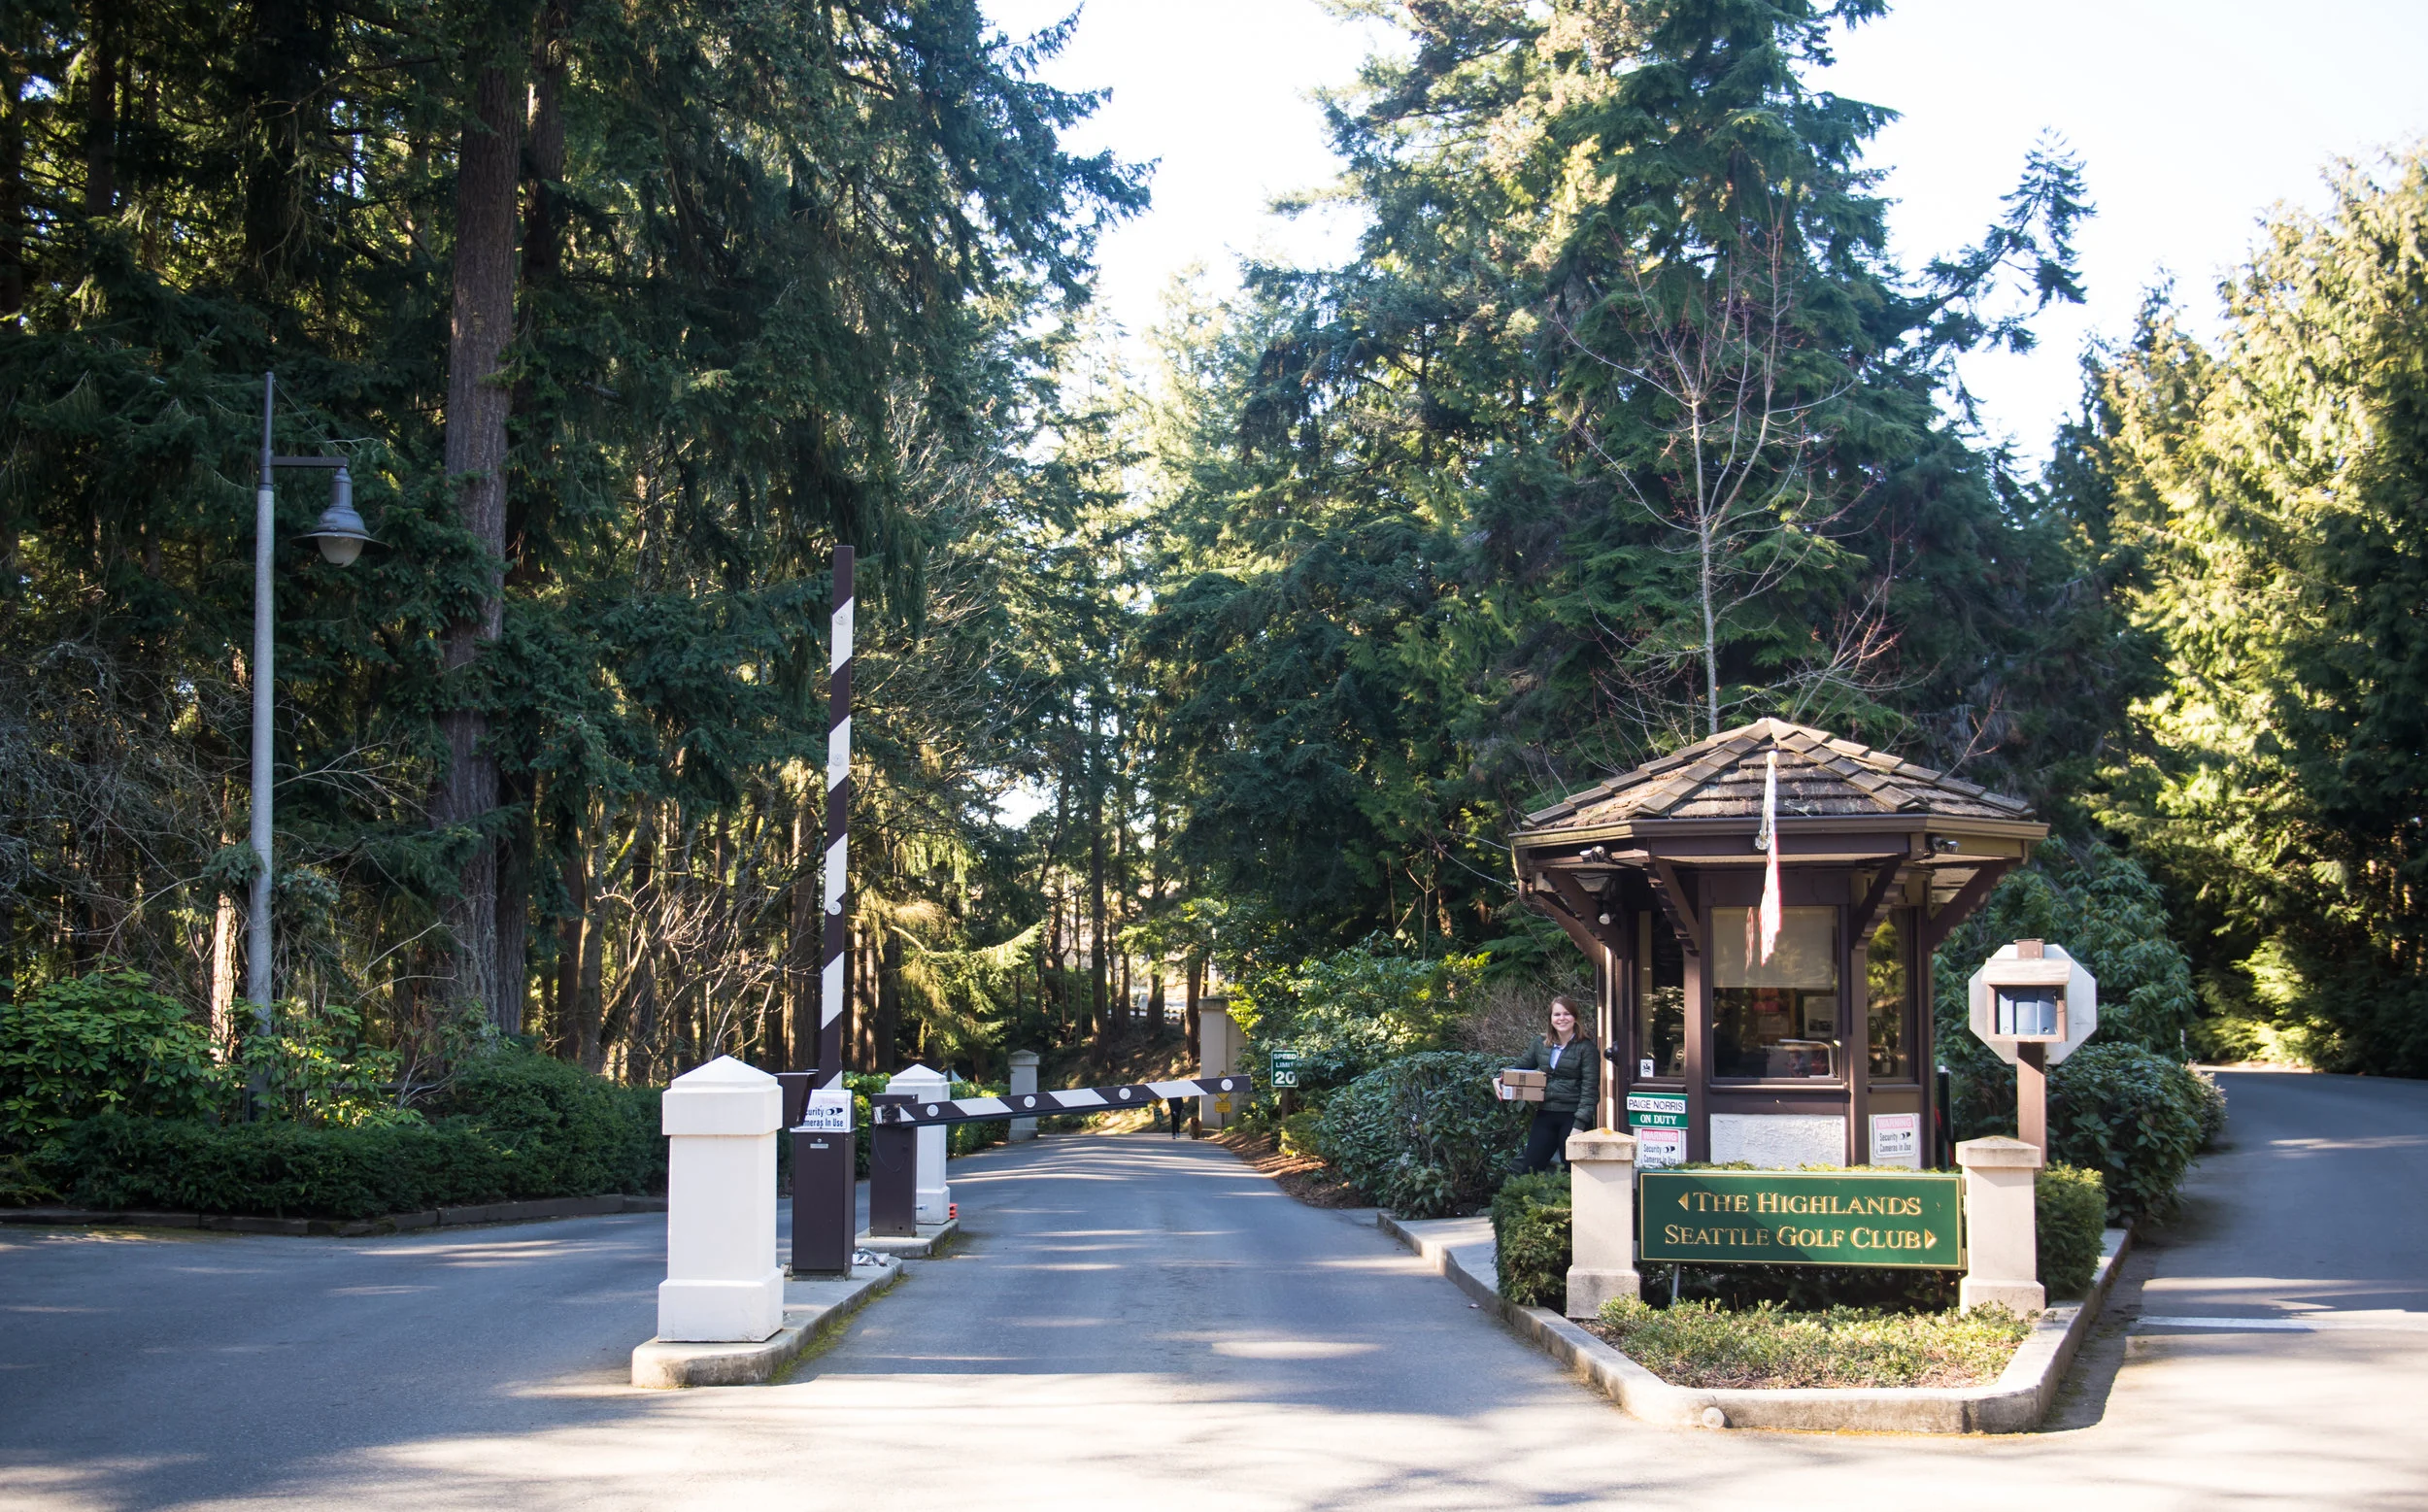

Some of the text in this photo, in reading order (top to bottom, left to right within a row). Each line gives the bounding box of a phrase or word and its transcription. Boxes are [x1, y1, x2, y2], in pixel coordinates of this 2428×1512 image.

[1274, 1070, 1296, 1085] 20
[1629, 1099, 1684, 1112] PAIGE NORRIS
[833, 1118, 843, 1126] Use
[1639, 1114, 1677, 1125] ON DUTY
[1643, 1130, 1677, 1141] WARNING
[1879, 1132, 1898, 1142] Security
[1643, 1144, 1662, 1154] Security
[1879, 1144, 1898, 1153] Cameras
[1693, 1192, 1922, 1216] THE HIGHLANDS
[1665, 1224, 1921, 1250] SEATTLE GOLF CLUB
